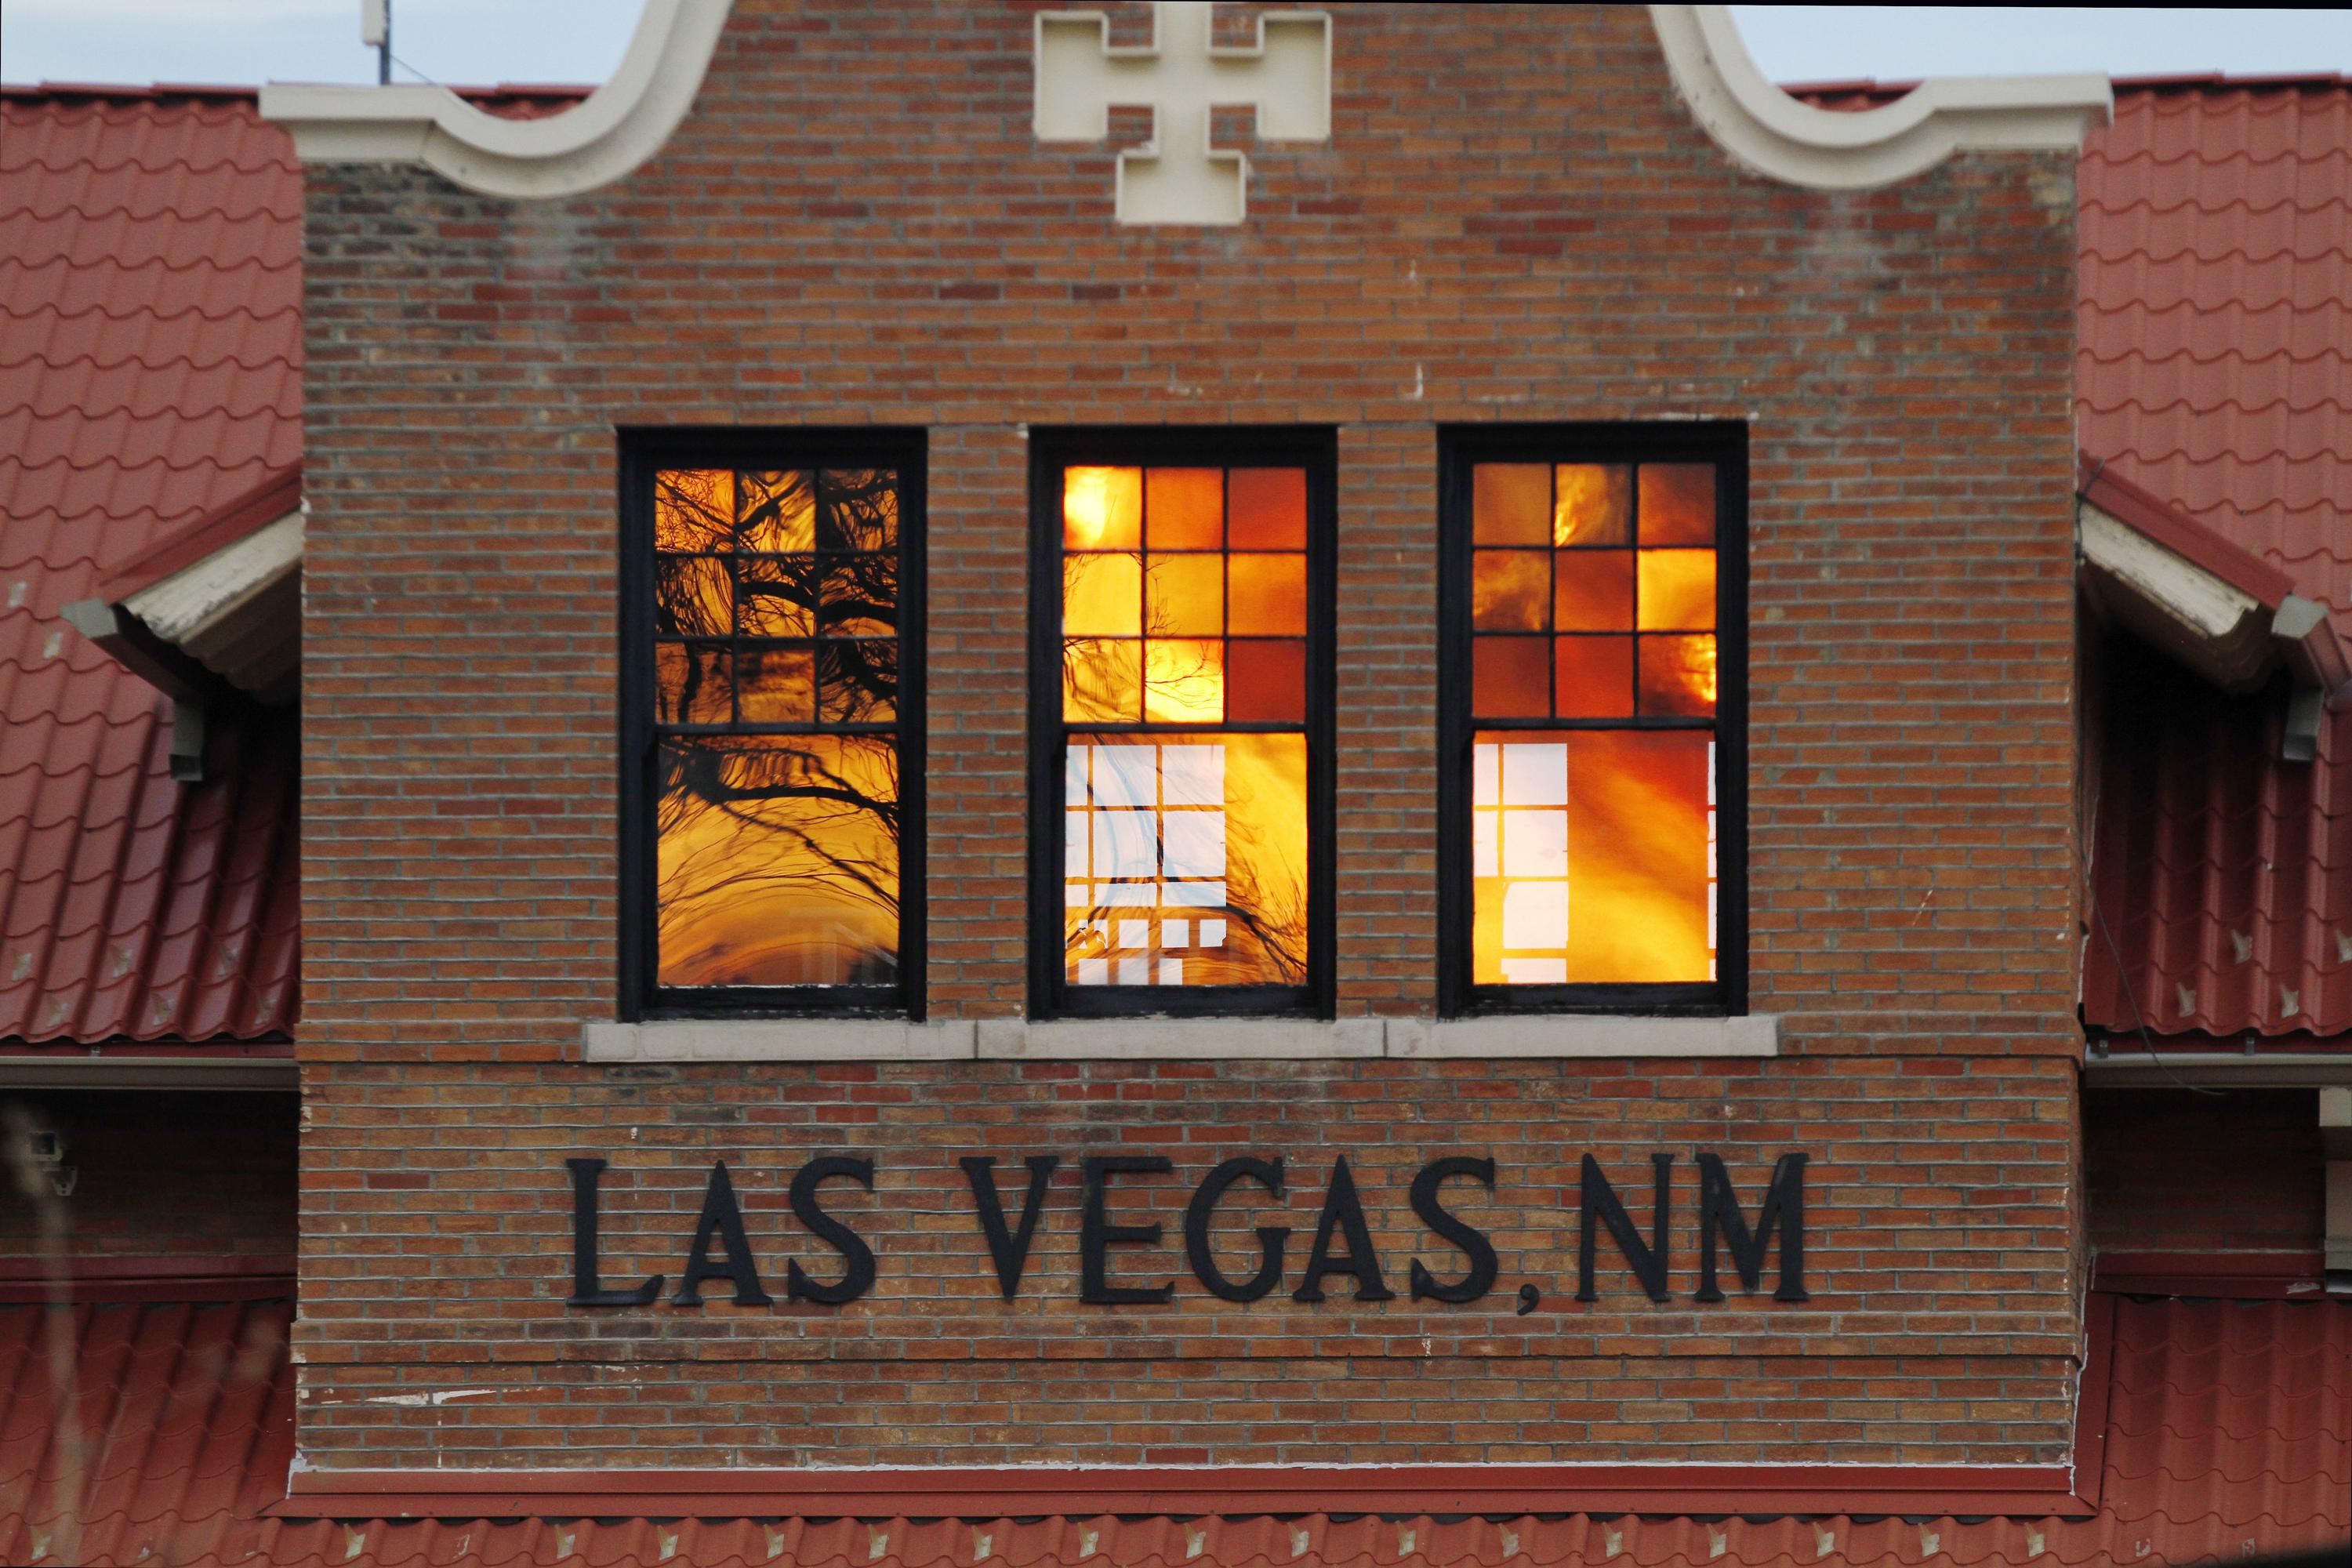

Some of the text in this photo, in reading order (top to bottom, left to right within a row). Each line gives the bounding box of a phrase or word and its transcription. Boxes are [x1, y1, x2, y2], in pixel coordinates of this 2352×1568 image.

[565, 1150, 1811, 1316] LAS VEGAS, NM
